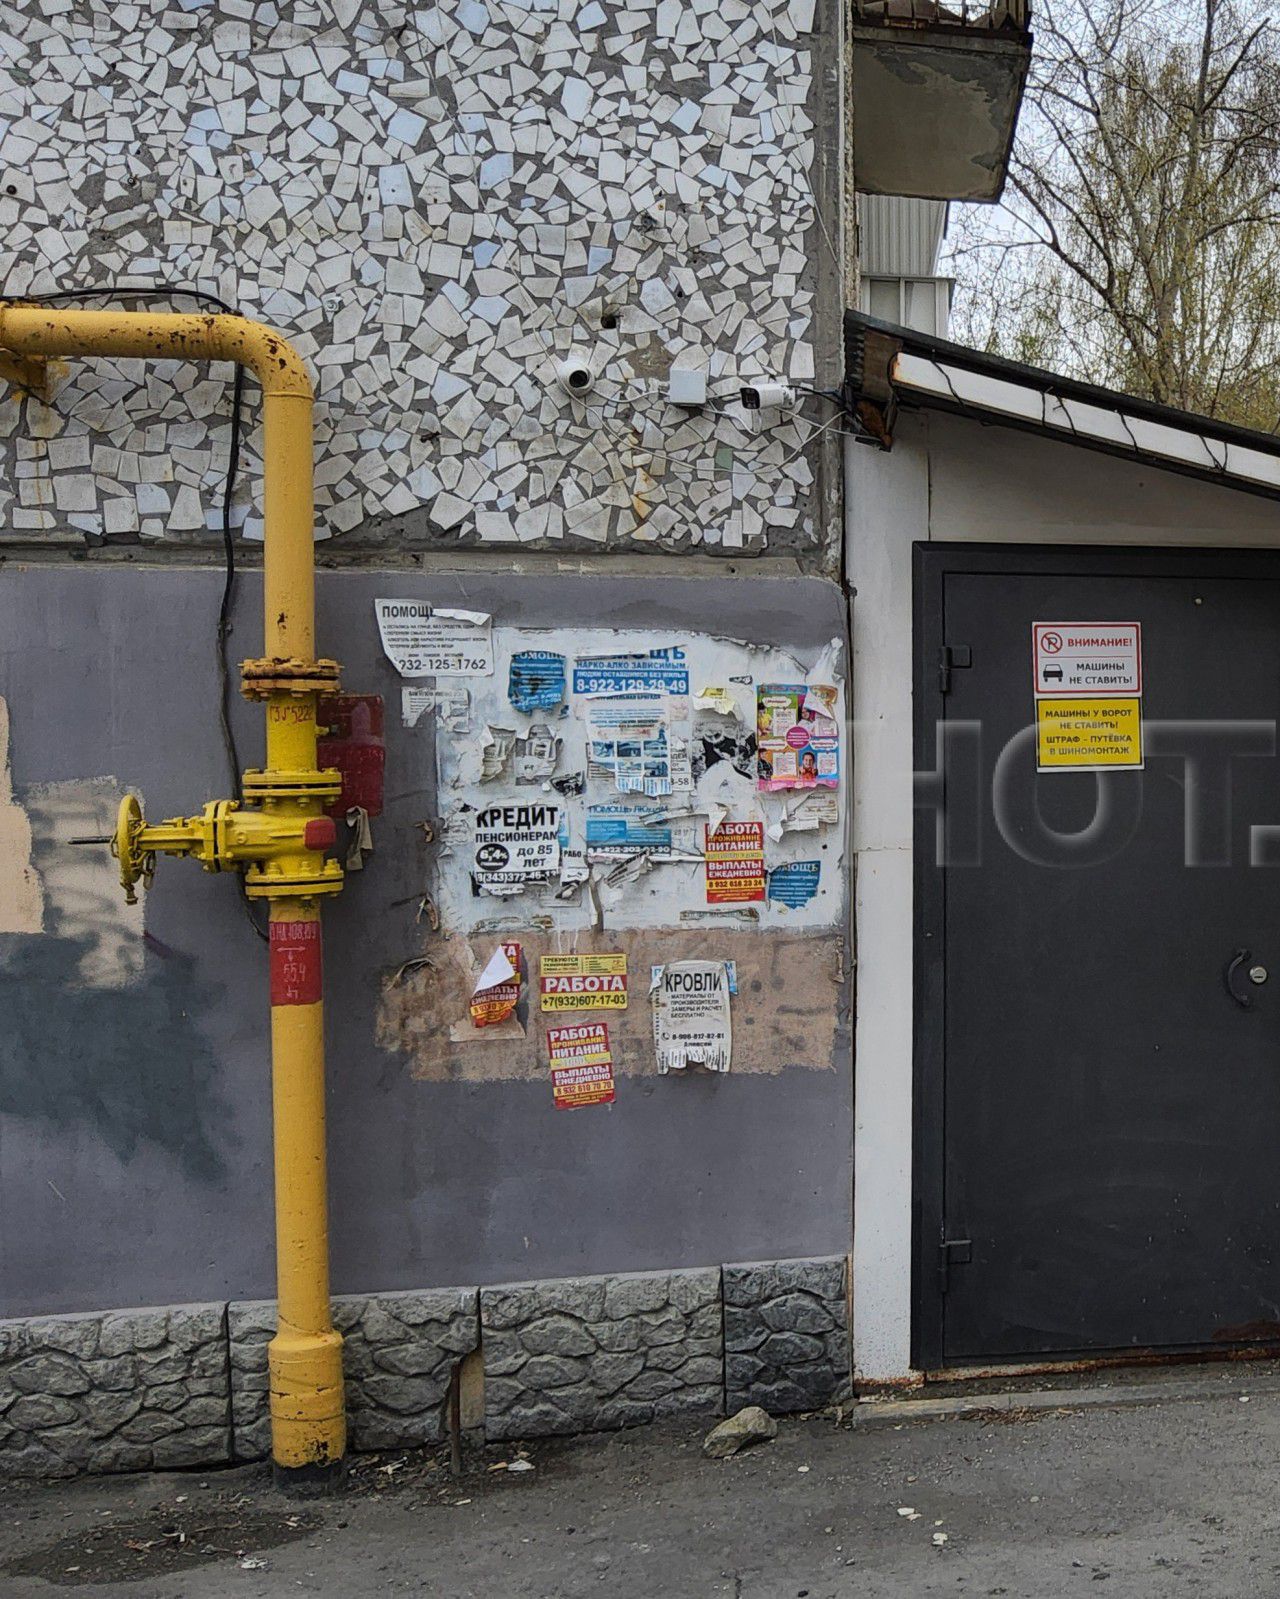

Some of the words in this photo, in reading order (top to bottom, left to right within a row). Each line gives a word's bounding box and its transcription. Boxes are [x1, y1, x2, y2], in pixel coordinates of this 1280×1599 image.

[1067, 638, 1132, 647] ВНИМАНИЕ!
[1076, 663, 1125, 671] МАШИНЫ
[1069, 677, 1082, 685] НЕ
[1085, 676, 1132, 685] СТАВИТЬ!
[1045, 709, 1091, 718] МАШИНЫ
[1093, 709, 1099, 717] У
[1102, 709, 1132, 718] ВОРОТ
[1060, 722, 1072, 730] НЕ
[1074, 721, 1119, 729] СТАВИТЬ!
[1046, 736, 1081, 744] ШТРАФ
[1090, 733, 1132, 743] ПУТЁВКА
[1058, 746, 1129, 756] ШИНОМОНТАЖ
[476, 806, 559, 831] КРЕДИТ
[517, 847, 535, 857] до
[537, 844, 553, 855] 85
[708, 841, 762, 851] ПИТАНИЕ
[522, 858, 547, 868] лет
[708, 861, 762, 871] ВЫПЛАТЫ
[709, 869, 762, 879] ЕЖЕДНЕВНО
[545, 976, 625, 993] РАБОТА
[665, 972, 722, 993] КРОВЛИ
[542, 994, 626, 1009] +7(932)607-17-03
[549, 1025, 605, 1042] РАБОТА
[552, 1043, 607, 1059] ПИТАНИЕ
[554, 1064, 610, 1080] ВЫПЛАТЫ
[555, 1072, 611, 1087] ЕЖЕДНЕВНО
